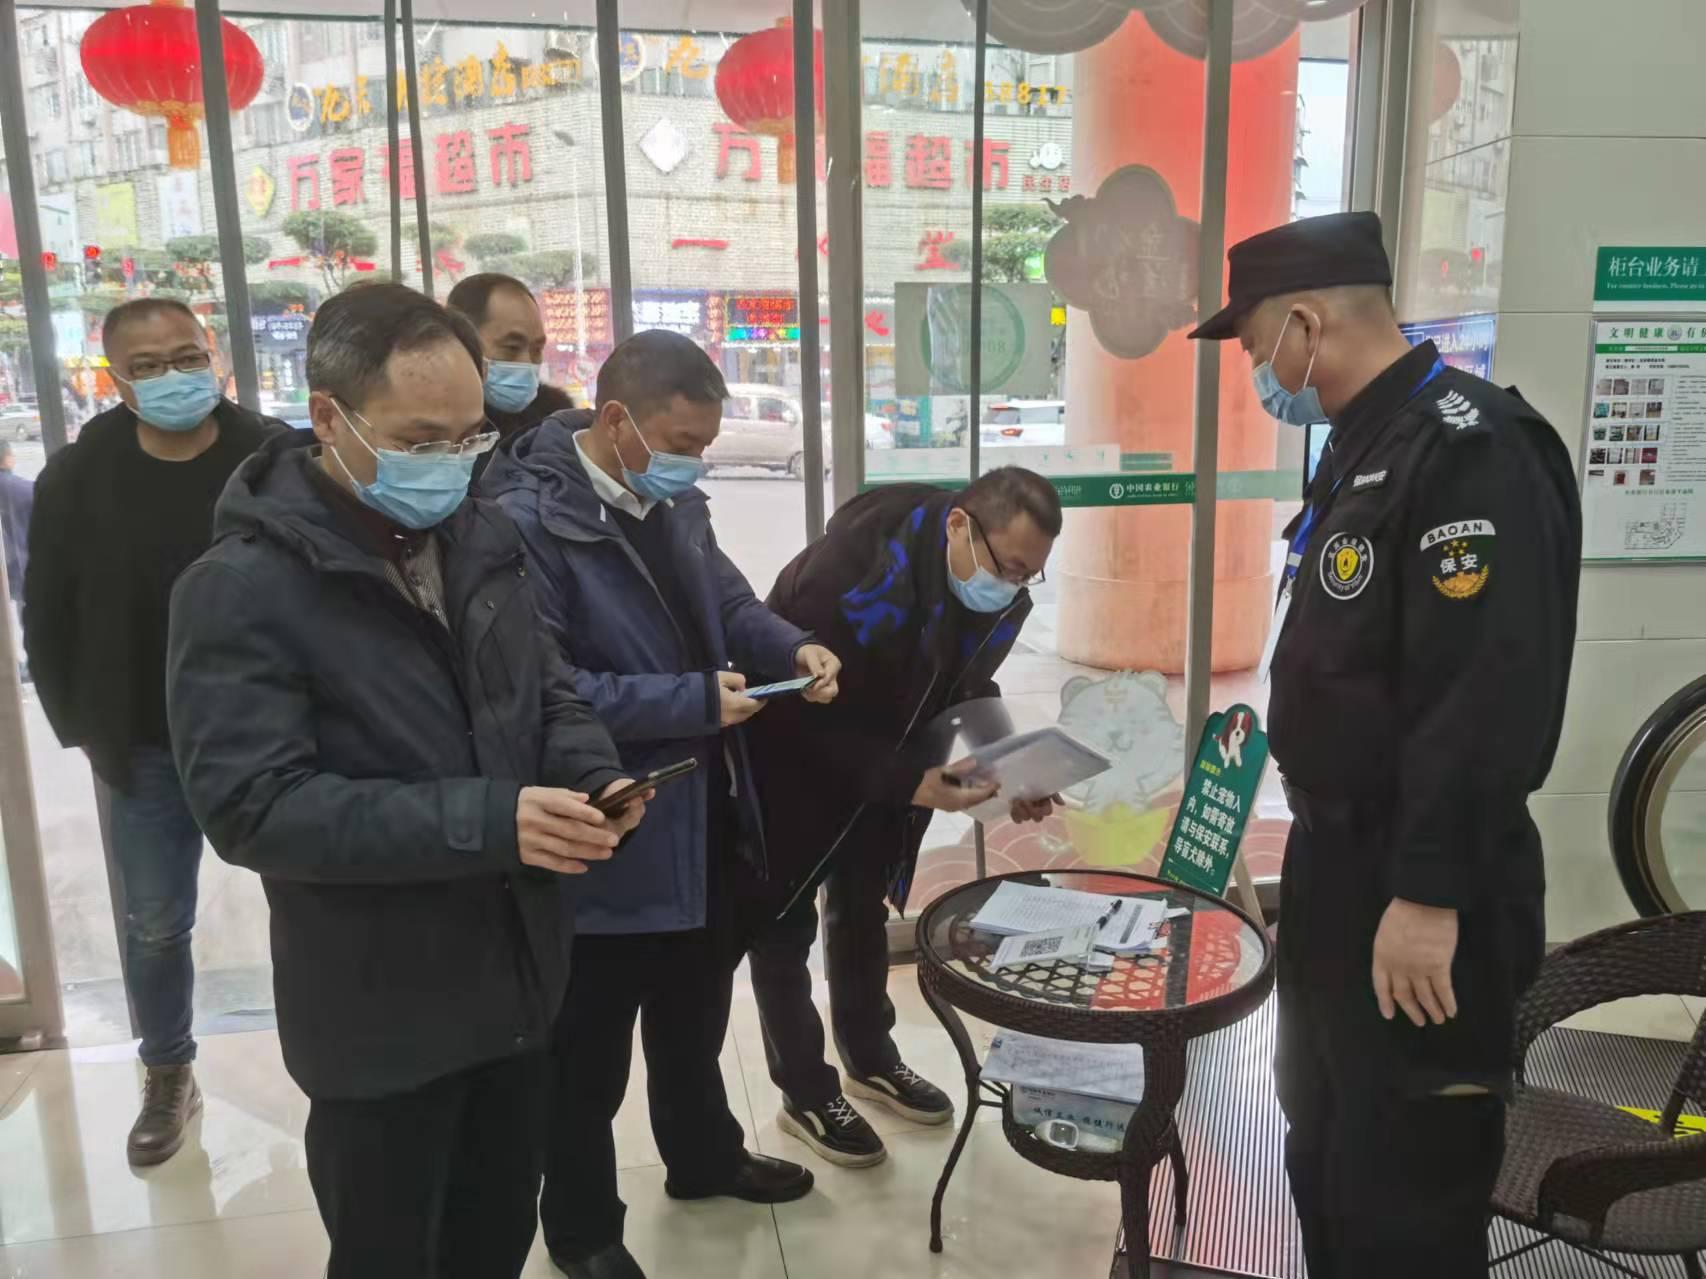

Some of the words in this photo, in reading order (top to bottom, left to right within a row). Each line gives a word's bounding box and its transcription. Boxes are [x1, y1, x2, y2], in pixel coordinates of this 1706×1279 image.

[287, 121, 532, 211] 万家福超市
[712, 122, 1010, 191] 万福超市
[1609, 256, 1706, 277] 柜台业务请
[1126, 483, 1179, 493] 中国农业银行
[1427, 521, 1483, 544] BAOAN
[1439, 553, 1479, 574] 保安
